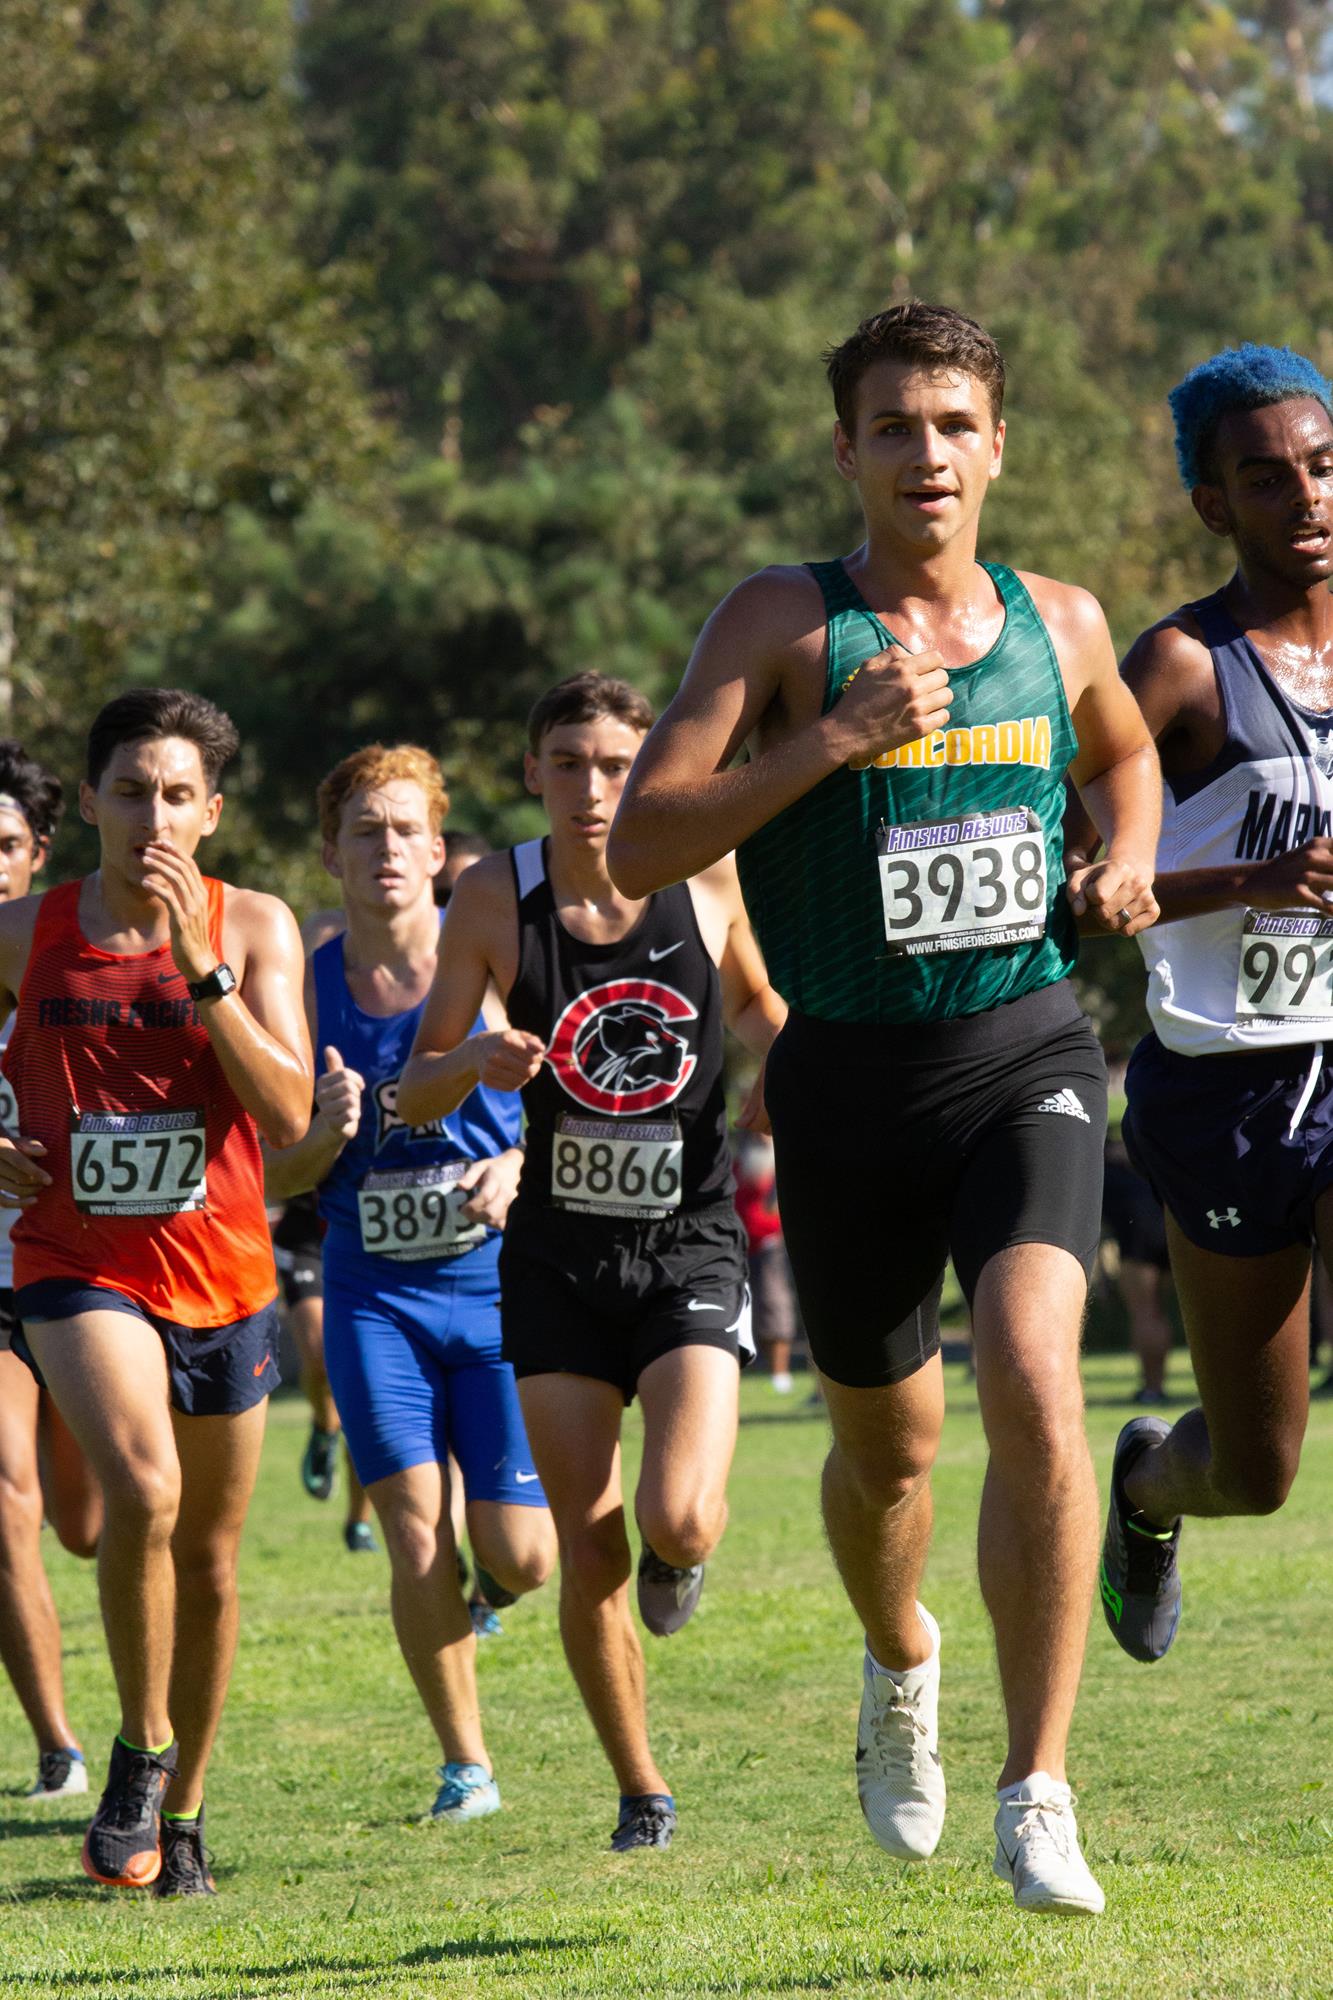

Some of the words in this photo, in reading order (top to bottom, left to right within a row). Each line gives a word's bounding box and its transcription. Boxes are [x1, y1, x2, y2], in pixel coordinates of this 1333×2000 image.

[849, 715, 1051, 771] NCORDIA
[887, 823, 960, 852] FINISHED
[962, 811, 1028, 842] RESULTS
[886, 841, 1044, 930] 3938
[906, 926, 1039, 955] WWW.FINISHEDRESULTS.COM
[1252, 912, 1321, 936] FINISHED
[1243, 941, 1333, 1007] 99
[128, 999, 201, 1027] PACIFI
[80, 1113, 138, 1132] FINISHED
[138, 1112, 197, 1130] RESULTS
[1037, 1102, 1091, 1124] adidas
[616, 1124, 674, 1140] RESULTS
[76, 1134, 203, 1193] 6572
[556, 1140, 679, 1198] 8866
